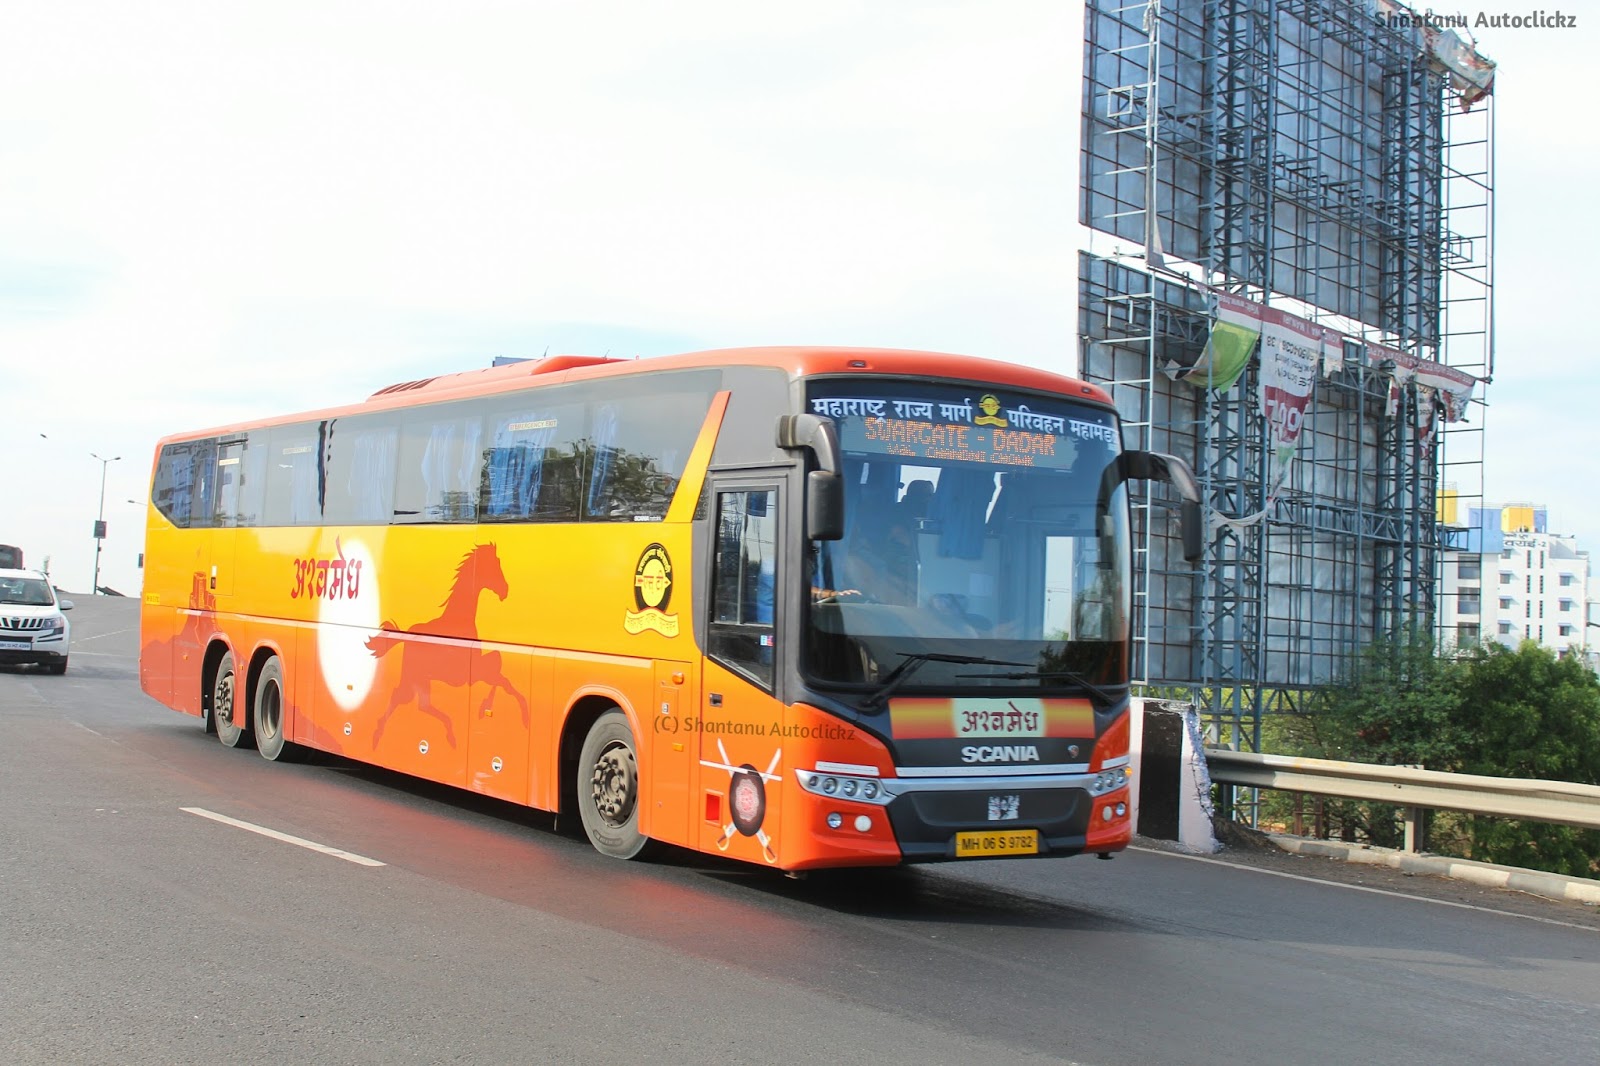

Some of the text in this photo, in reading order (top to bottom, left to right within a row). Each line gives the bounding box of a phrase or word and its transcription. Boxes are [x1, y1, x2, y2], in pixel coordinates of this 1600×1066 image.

[811, 398, 887, 423] महाराष्ट्र
[892, 400, 934, 420] राज्य
[939, 398, 972, 422] मार्ग
[1006, 405, 1065, 434] परिवहन
[992, 429, 1057, 456] DADAR
[961, 746, 1040, 763] SCANIA
[961, 835, 1033, 851] MH 06 S 9782
